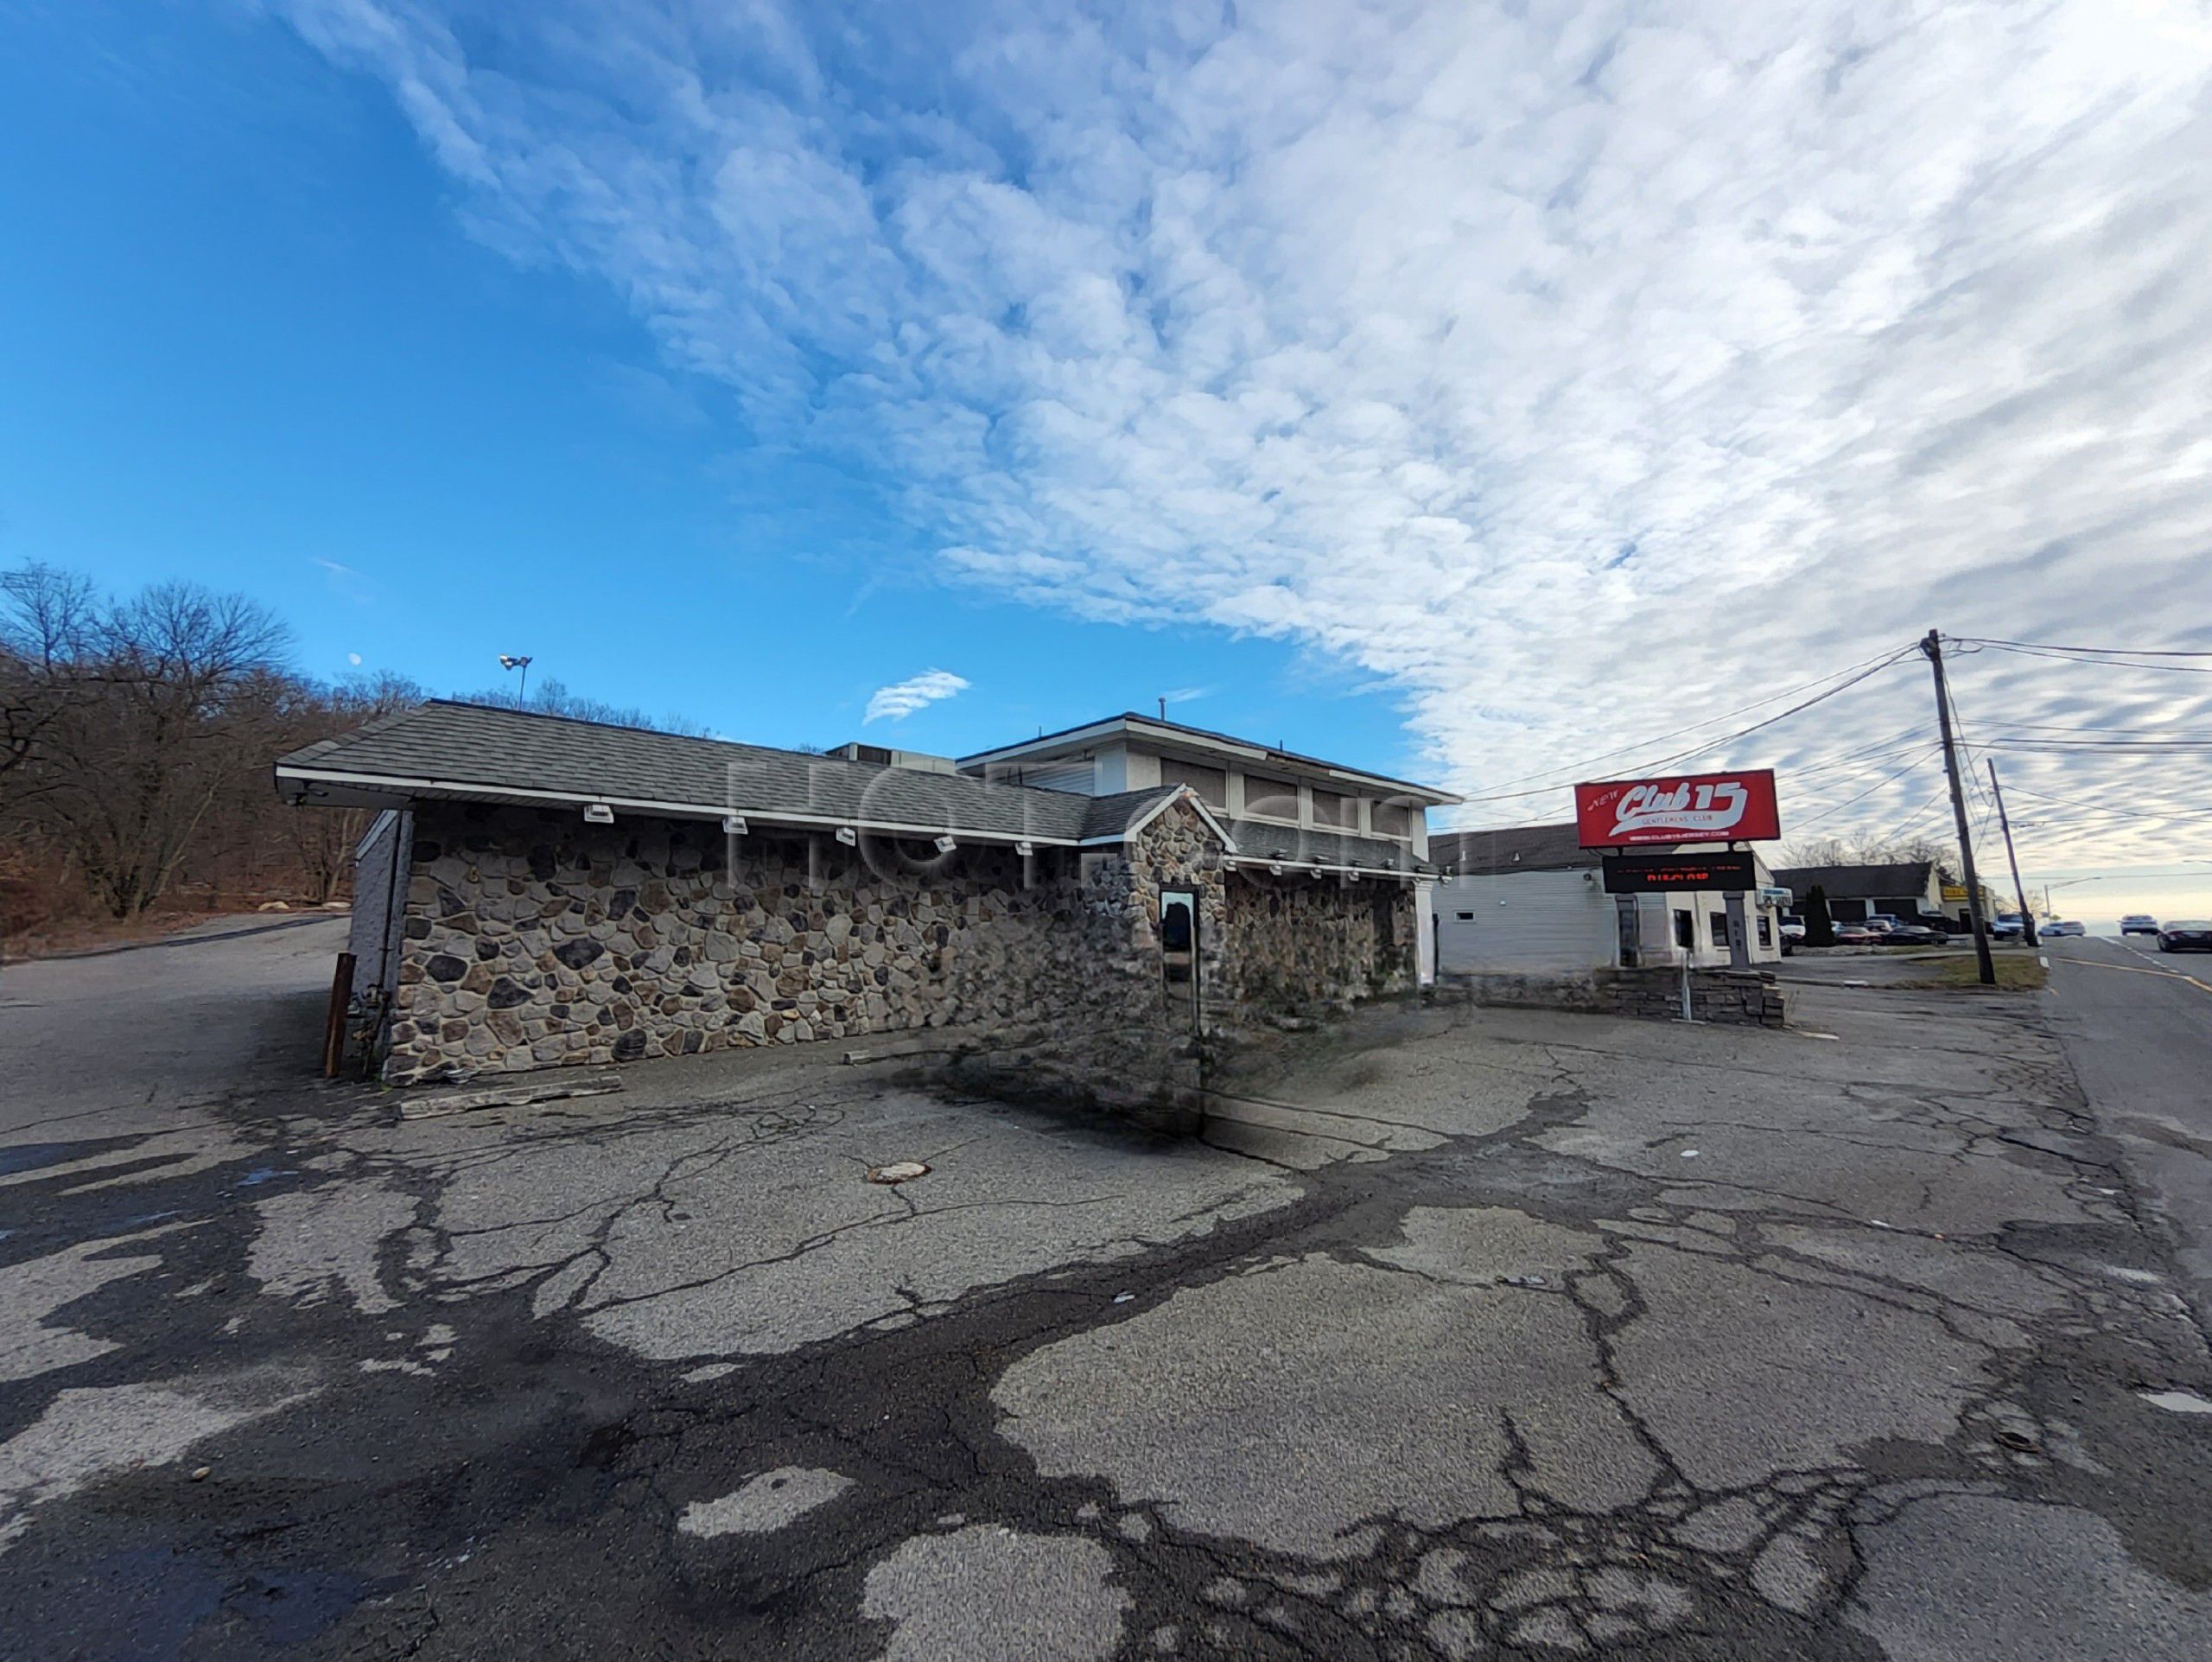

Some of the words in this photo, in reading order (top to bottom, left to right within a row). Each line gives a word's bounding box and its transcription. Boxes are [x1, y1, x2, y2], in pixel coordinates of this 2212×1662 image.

[1587, 790, 1618, 811] NEW
[1615, 782, 1691, 821] Club
[1694, 782, 1748, 825] 15
